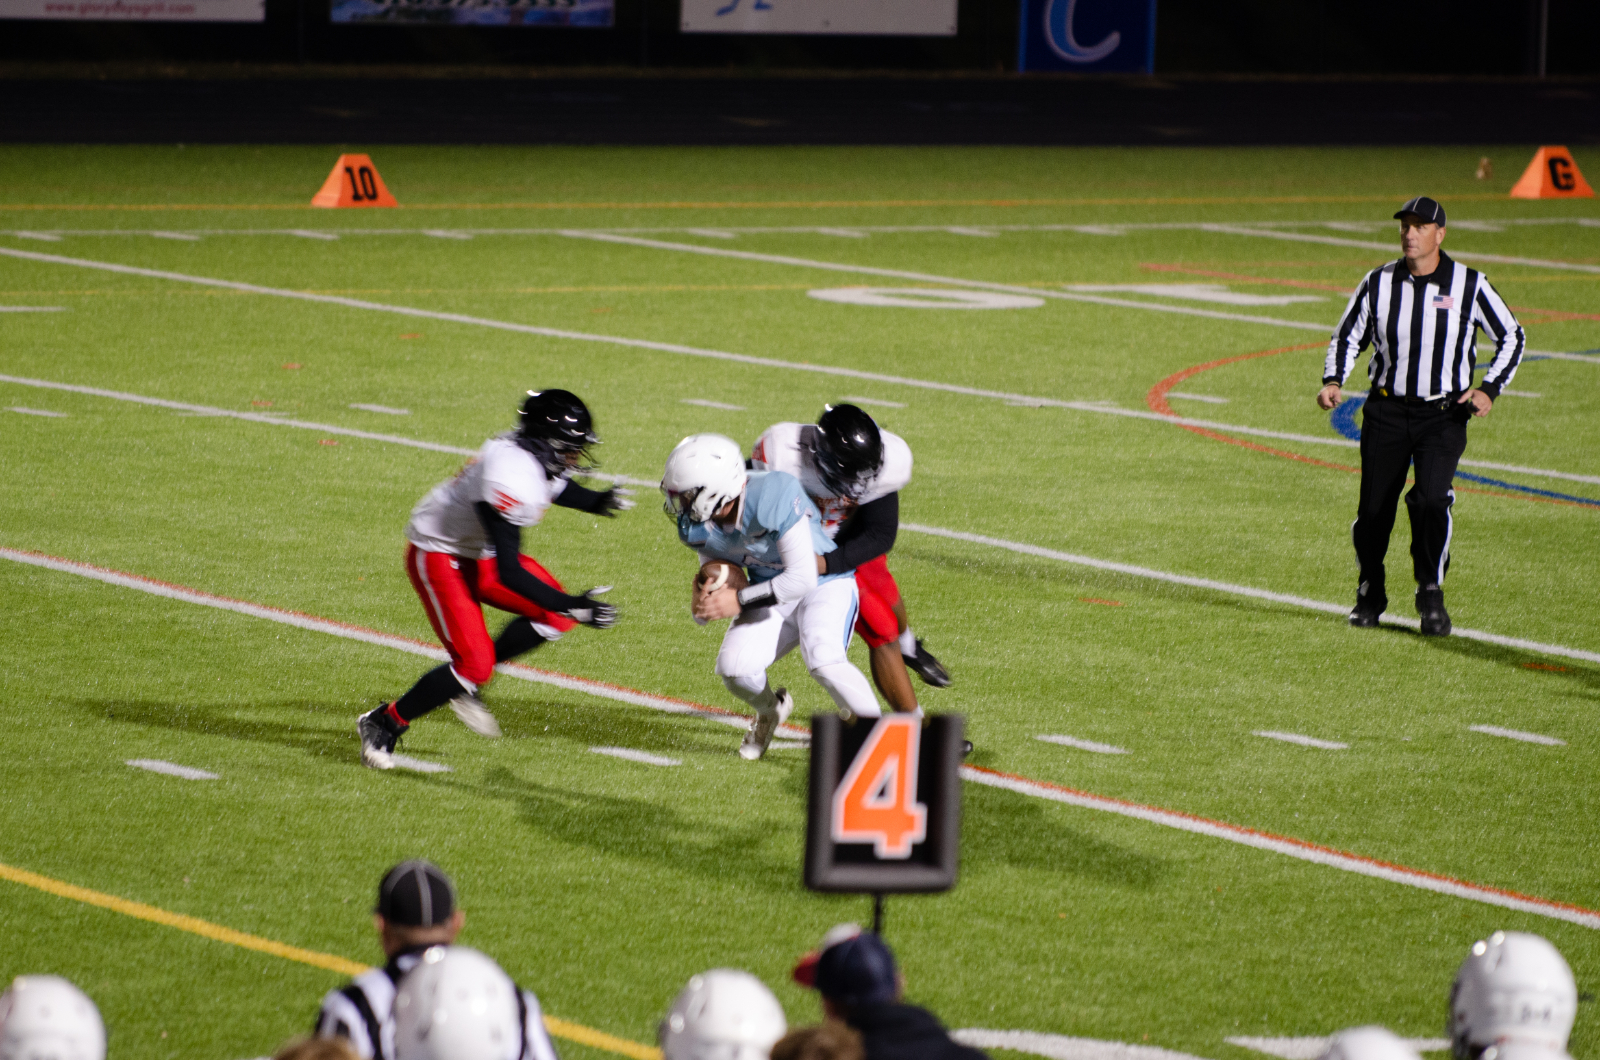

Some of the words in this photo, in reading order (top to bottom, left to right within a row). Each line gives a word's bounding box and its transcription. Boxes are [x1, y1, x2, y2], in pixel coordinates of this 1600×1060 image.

[345, 166, 378, 201] 10
[1548, 157, 1576, 191] G
[830, 712, 928, 860] 4
